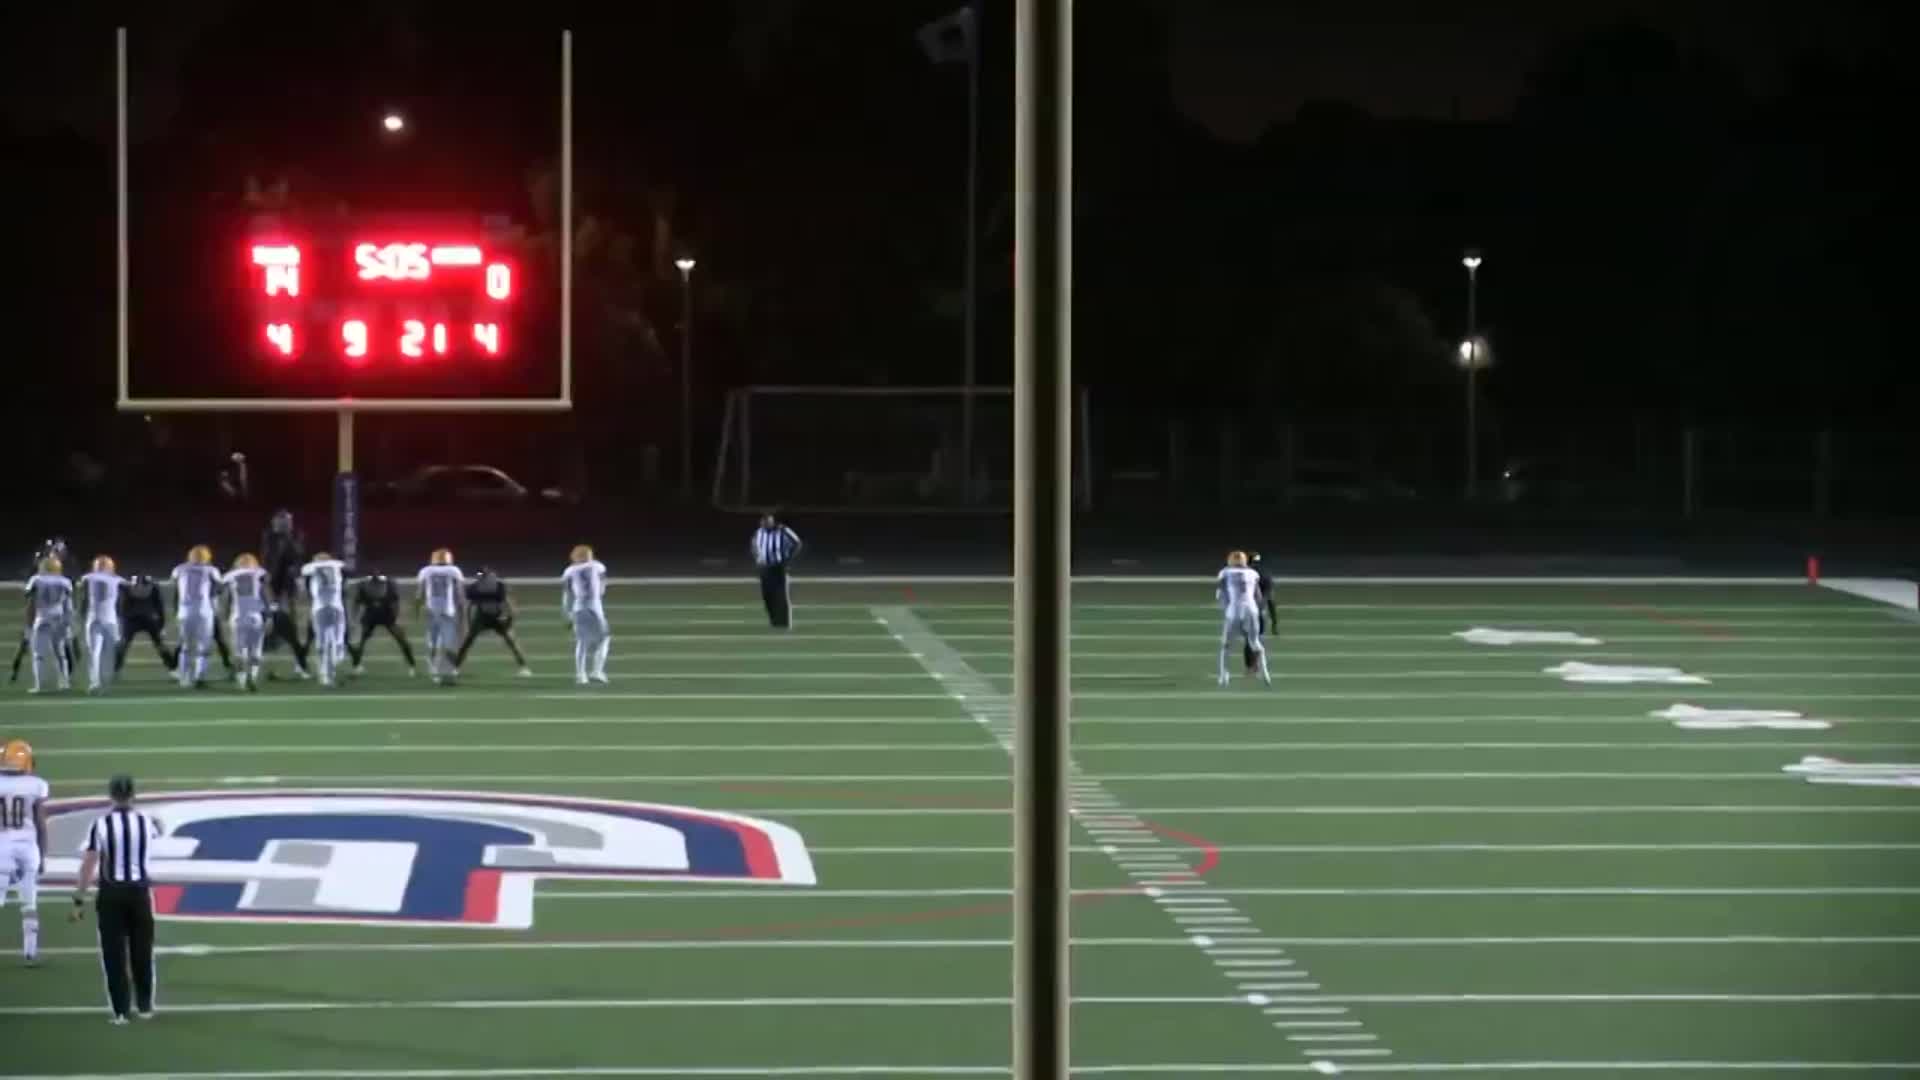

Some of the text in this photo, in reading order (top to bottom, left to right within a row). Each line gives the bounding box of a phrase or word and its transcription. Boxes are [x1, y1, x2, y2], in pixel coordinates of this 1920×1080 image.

[355, 243, 431, 279] 5:05
[486, 263, 511, 299] 0
[267, 322, 292, 355] 4
[342, 320, 367, 357] 9
[473, 322, 498, 355] 4
